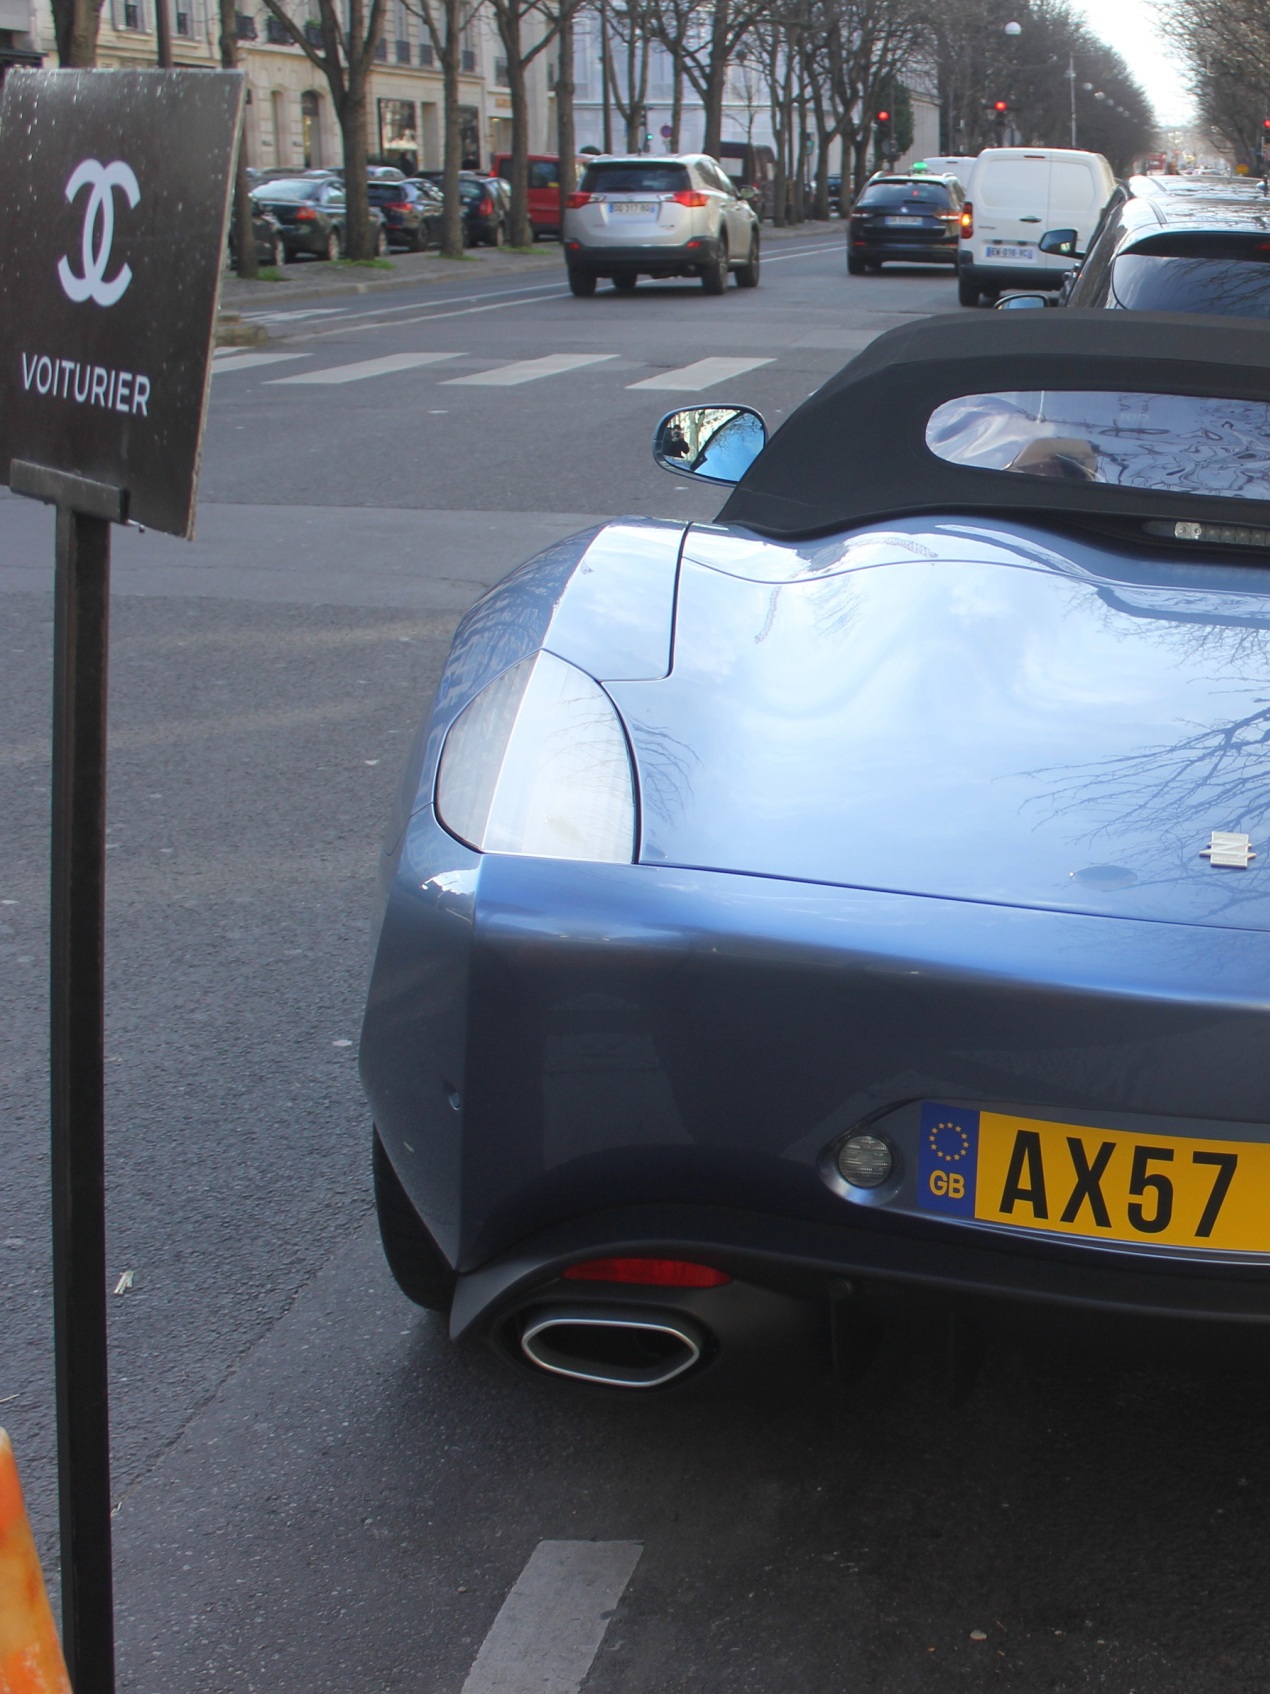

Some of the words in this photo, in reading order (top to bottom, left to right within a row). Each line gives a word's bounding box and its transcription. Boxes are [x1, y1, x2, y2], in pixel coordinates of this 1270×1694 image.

[22, 353, 150, 416] VOITURIER
[929, 1169, 965, 1199] GB
[999, 1129, 1239, 1239] AX57
